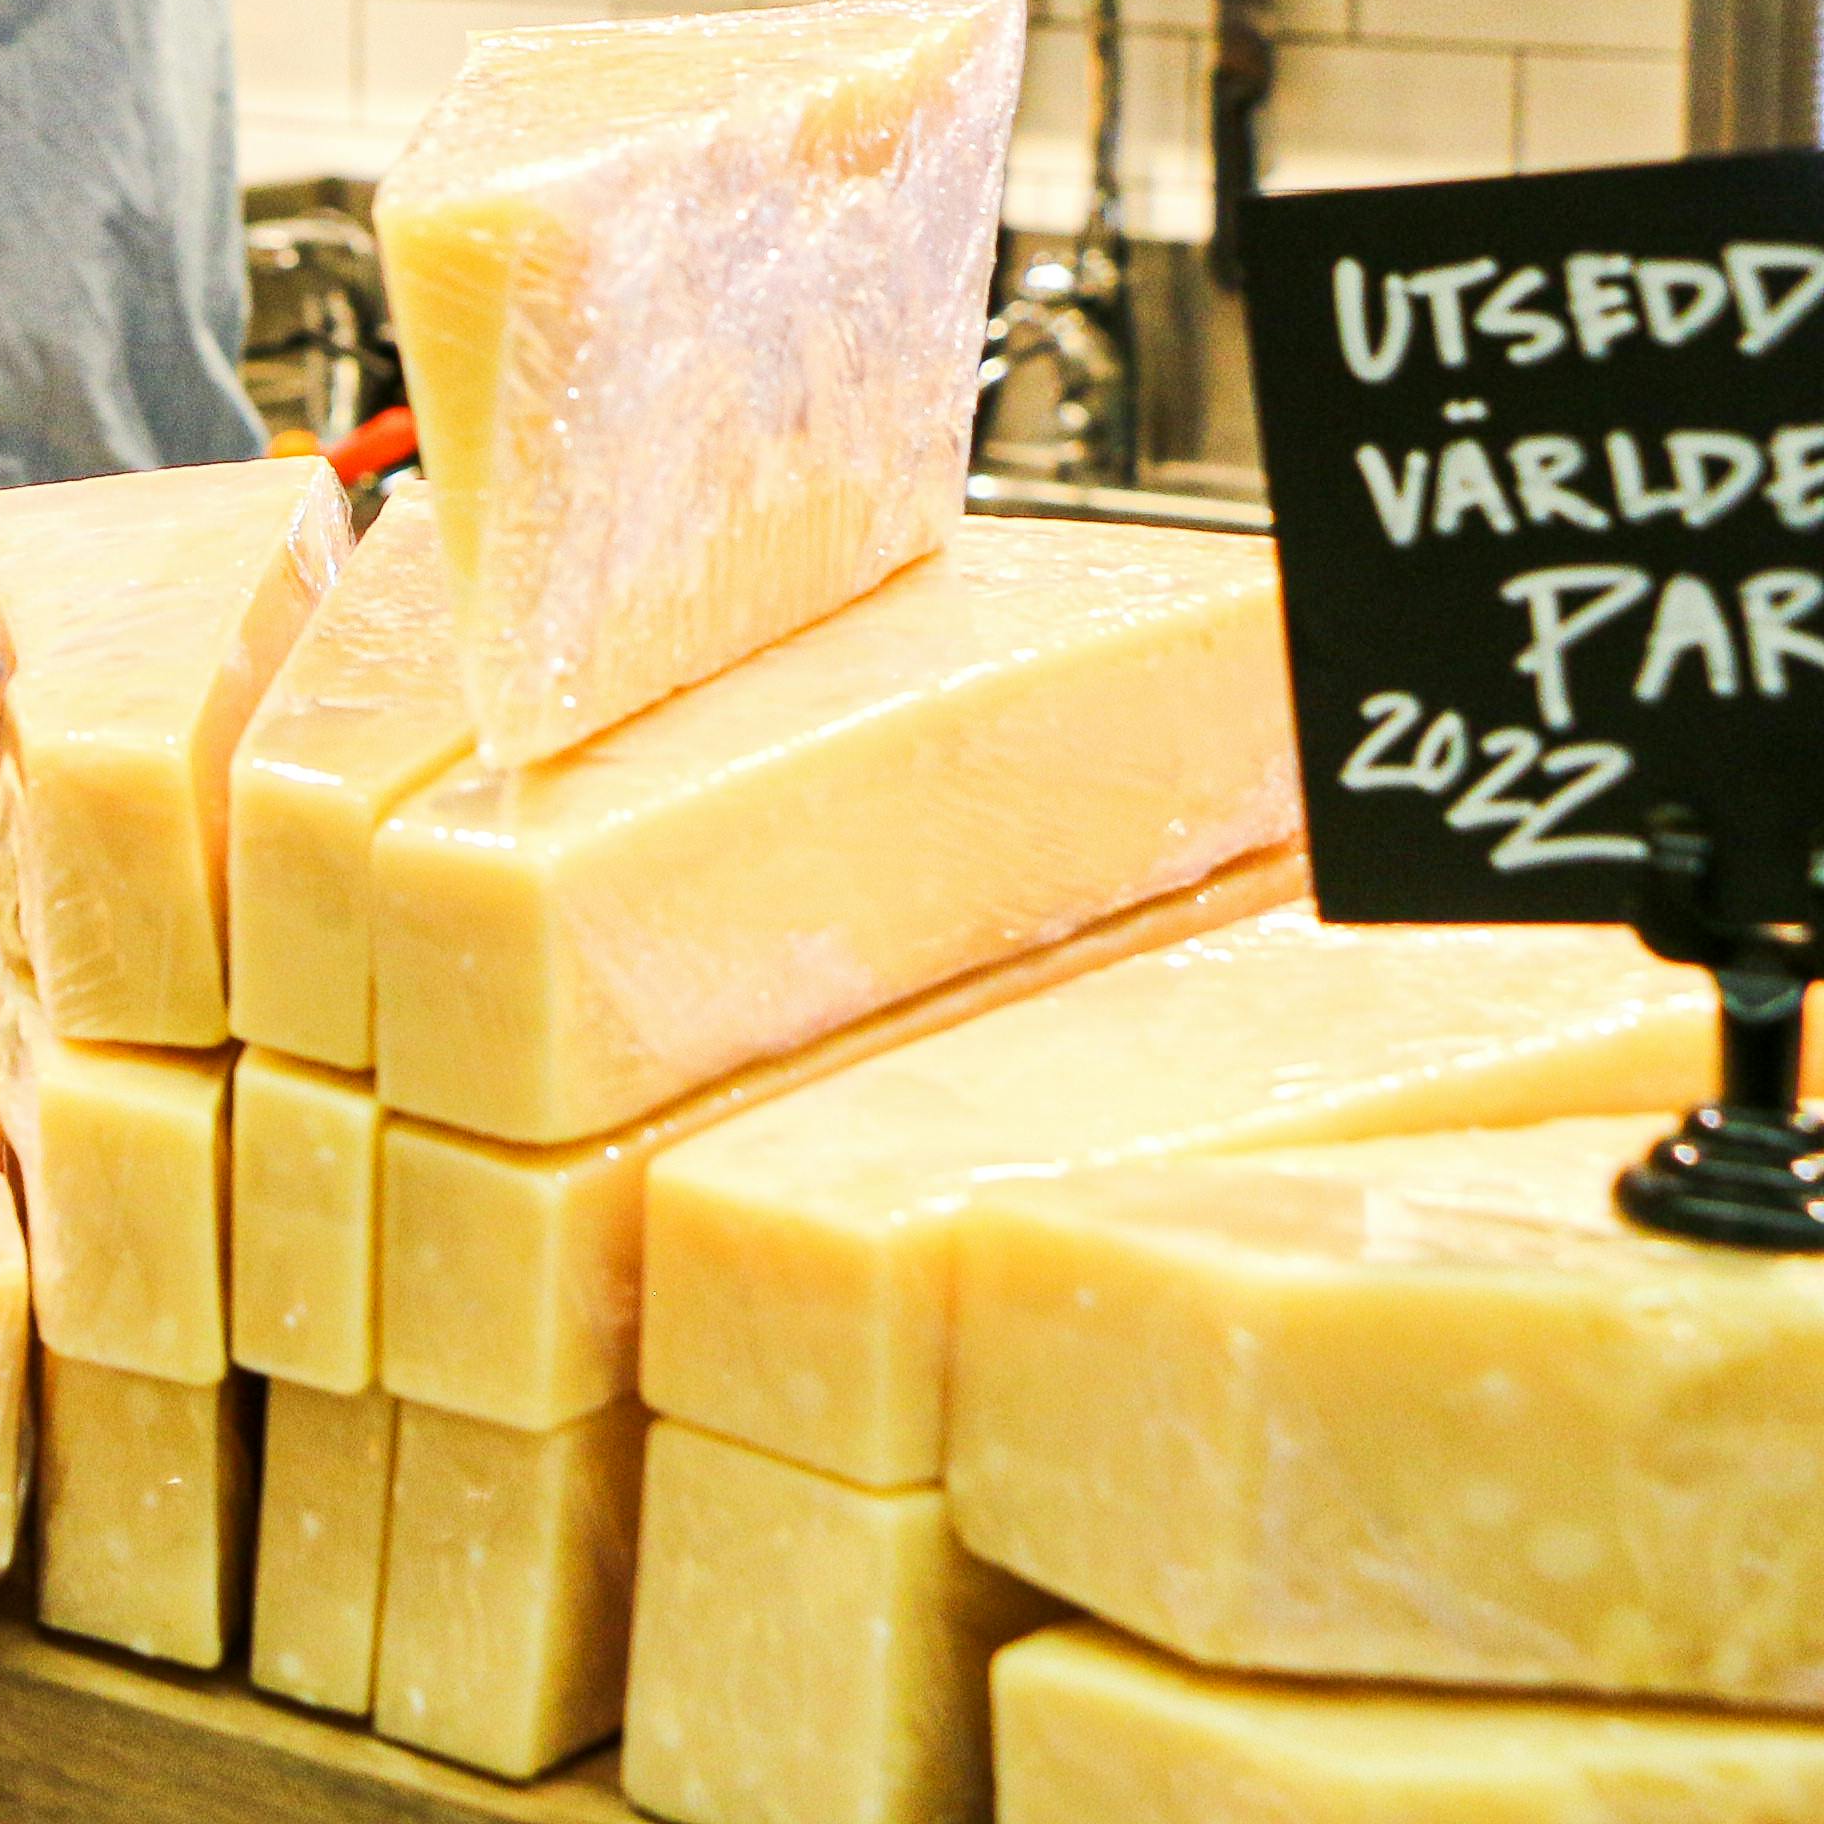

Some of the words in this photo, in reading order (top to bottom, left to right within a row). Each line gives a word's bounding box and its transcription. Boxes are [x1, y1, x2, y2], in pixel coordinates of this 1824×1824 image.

[1356, 399, 1824, 547] VÄRLDE
[1500, 564, 1824, 729] PAR
[1339, 691, 1651, 872] 2022
